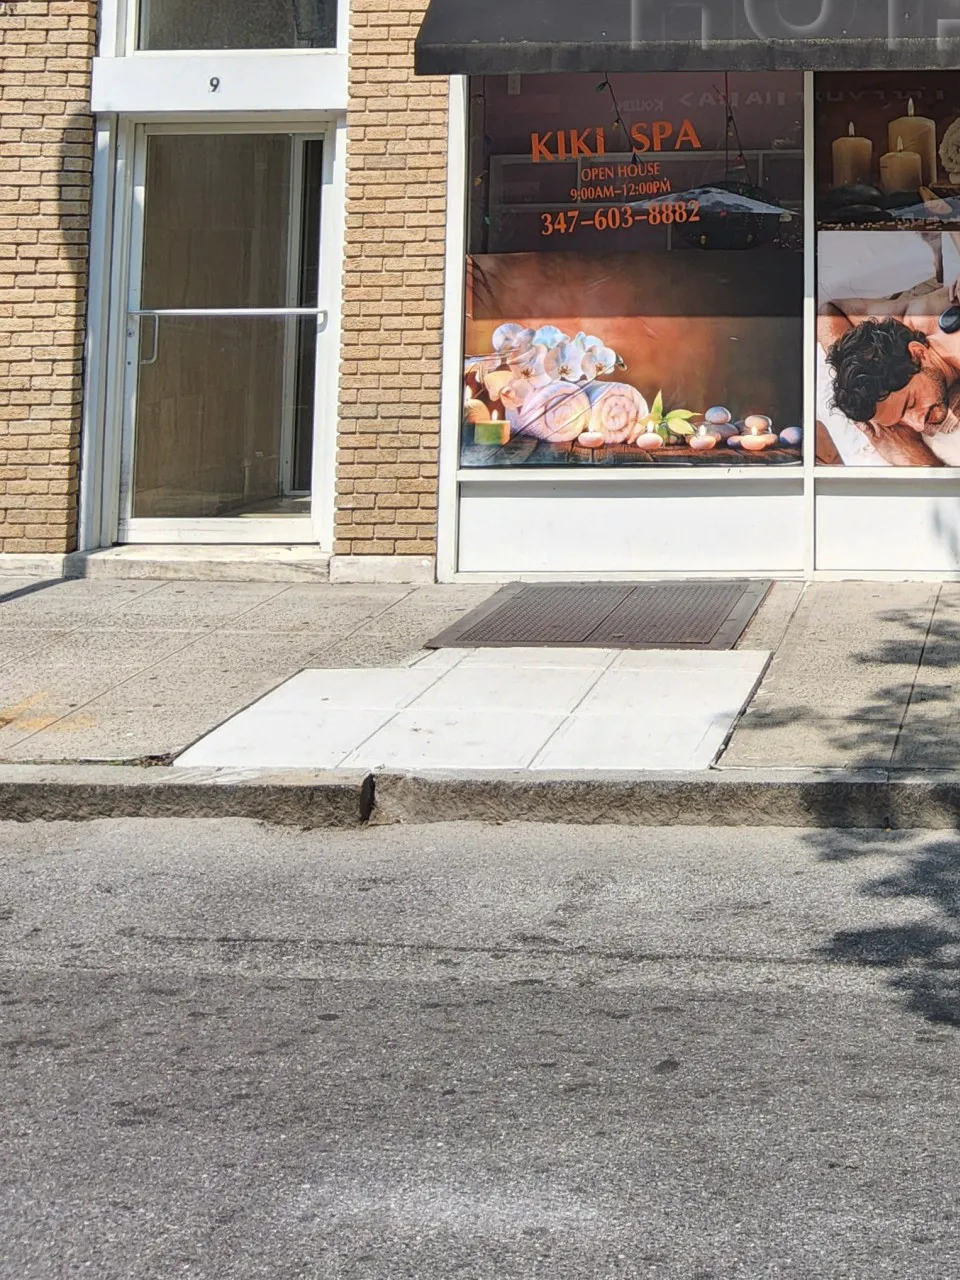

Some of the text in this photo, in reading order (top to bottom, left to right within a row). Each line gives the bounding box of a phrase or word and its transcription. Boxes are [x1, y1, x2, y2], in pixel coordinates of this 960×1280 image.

[209, 76, 221, 93] 9
[531, 119, 701, 163] KIKI SPA
[580, 162, 661, 182] OPEN HOUSE
[541, 199, 700, 236] 347-603-8882
